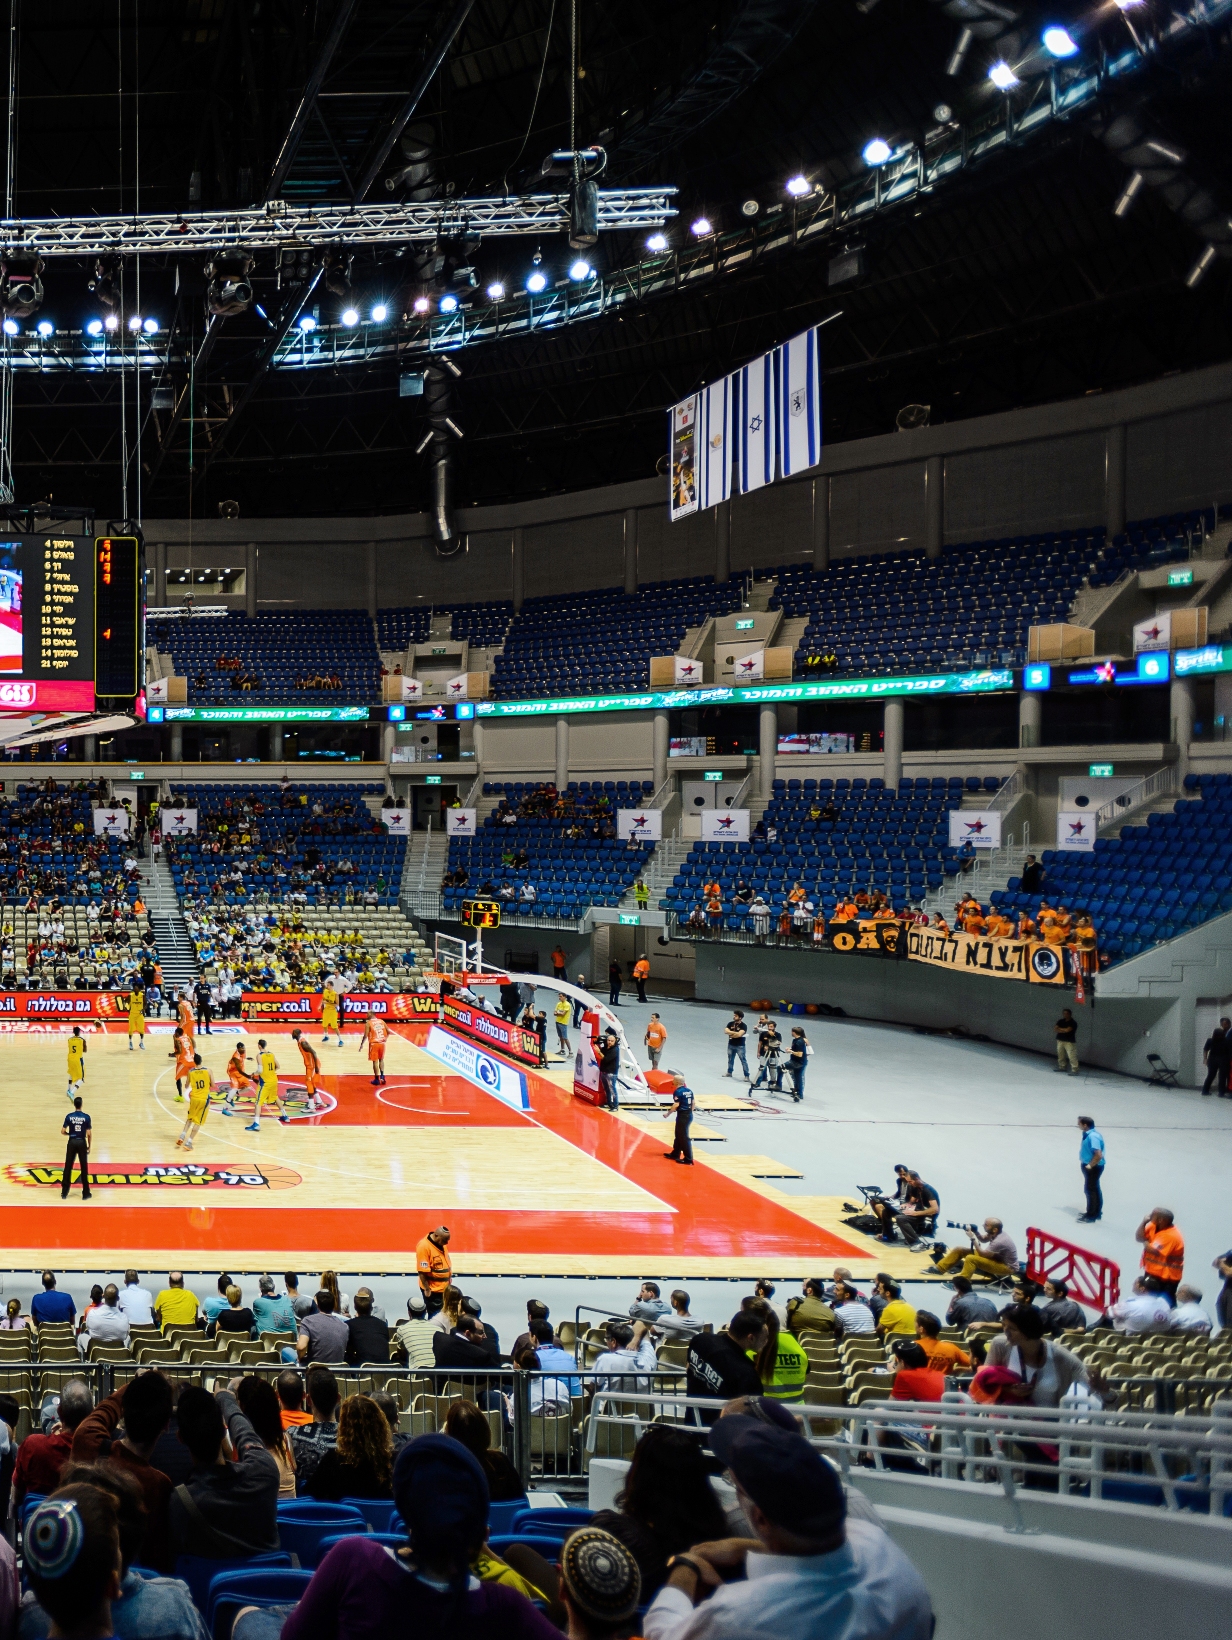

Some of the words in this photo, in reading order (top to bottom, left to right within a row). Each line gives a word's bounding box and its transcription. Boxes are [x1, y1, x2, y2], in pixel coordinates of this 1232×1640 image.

[45, 540, 51, 548] 4
[44, 562, 51, 570] 6
[42, 605, 51, 613] 10
[42, 616, 51, 624] 11
[42, 627, 51, 635] 12
[42, 638, 51, 646] 13
[42, 649, 51, 657] 14
[1176, 648, 1222, 670] Sprite
[1145, 661, 1159, 675] 6
[1031, 670, 1043, 684] 5
[806, 684, 867, 696] האהוב
[873, 679, 946, 692] ספרייט
[742, 688, 804, 699] והמוכר
[549, 701, 596, 710] האהוב
[599, 698, 653, 707] ספרייט
[392, 708, 401, 718] 4
[461, 706, 468, 716] 5
[501, 704, 546, 713] והמוכר
[152, 709, 160, 719] 4
[200, 711, 241, 719] והמוכר
[244, 711, 285, 719] האהוב
[287, 711, 332, 719] ספרייט
[909, 932, 959, 963] הכתום
[966, 942, 1024, 973] הצבא
[27, 996, 73, 1011] בסלולר!
[75, 999, 91, 1011] גם
[369, 1001, 386, 1012] גם
[499, 1029, 508, 1044] גם
[268, 1062, 273, 1071] 11
[195, 1080, 205, 1089] 10
[144, 1165, 209, 1177] ליגת
[218, 1171, 267, 1185] סל
